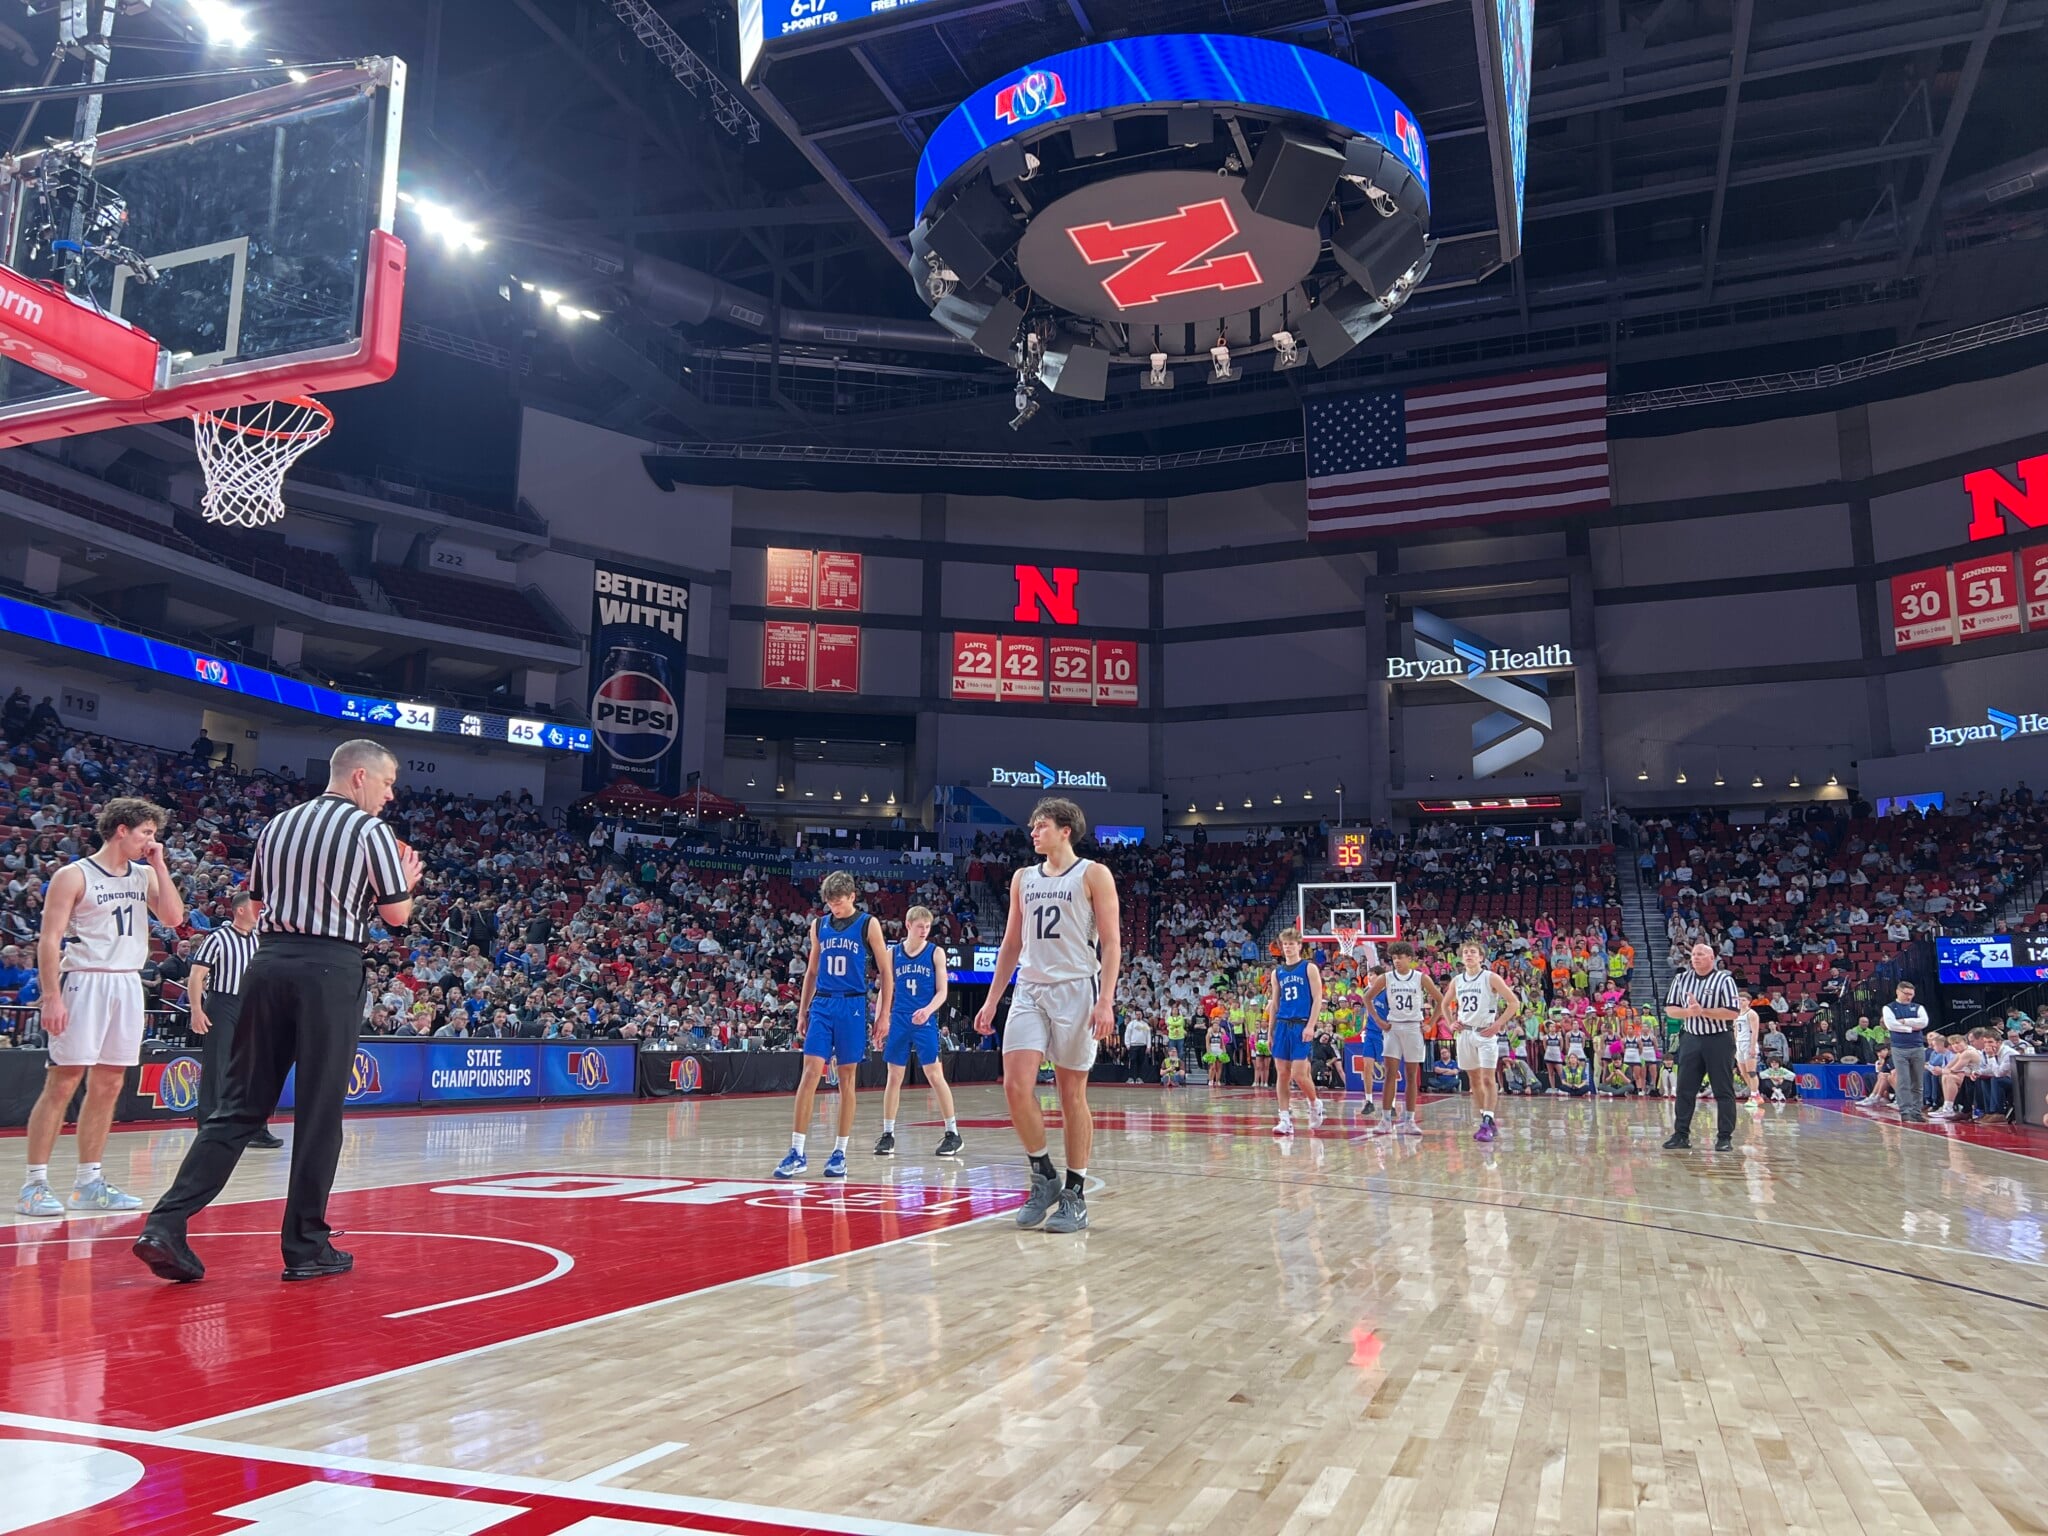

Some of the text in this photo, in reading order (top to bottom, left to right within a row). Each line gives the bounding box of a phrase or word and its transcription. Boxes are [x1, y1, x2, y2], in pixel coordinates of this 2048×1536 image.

[782, 11, 838, 33] 3-POINT FG
[1066, 197, 1262, 308] N
[1963, 453, 2048, 542] N
[437, 552, 462, 566] 222
[1961, 565, 2008, 580] JENNINGS
[595, 569, 689, 610] BETTER
[1014, 564, 1079, 625] N
[1910, 582, 1927, 591] IVY
[1968, 577, 2005, 607] 51
[1900, 591, 1940, 620] 30
[599, 597, 683, 642] WITH
[1961, 618, 1976, 630] N
[1897, 629, 1911, 642] N
[964, 642, 988, 650] LANTZ
[958, 651, 992, 674] 22
[1004, 654, 1038, 676] 42
[1054, 656, 1087, 679] 52
[1104, 659, 1131, 681] 10
[1386, 643, 1573, 682] Bryan Health
[64, 694, 95, 712] 119
[406, 709, 430, 726] 34
[462, 714, 481, 725] 4th
[512, 725, 534, 740] 45
[597, 702, 673, 731] PEPSI
[460, 723, 481, 736] 1:41
[1929, 724, 1997, 746] Bryan
[408, 760, 435, 773] 120
[611, 763, 656, 774] ZERO SUGAR
[991, 768, 1107, 787] Bryan Health
[1338, 846, 1362, 866] 35
[688, 859, 743, 872] ACCOUNTING
[753, 865, 795, 876] FIANCIAL
[872, 870, 904, 878] TALENT
[97, 892, 146, 905] CONCORDIA
[1025, 891, 1072, 904] CONCORDIA
[111, 904, 132, 936] 11
[1033, 905, 1060, 939] 12
[820, 938, 859, 955] BLUEJAYS
[1950, 937, 1995, 945] CONCORDIA
[946, 956, 991, 967] :41 45
[1989, 949, 2009, 961] 34
[827, 955, 847, 976] 10
[895, 964, 931, 978] BLUEJAYS
[906, 979, 917, 996] 4
[1285, 986, 1298, 1001] 23
[1395, 995, 1413, 1011] 34
[1462, 995, 1478, 1012] 23
[466, 1050, 502, 1068] STATE
[431, 1069, 531, 1088] CHAMPIONSHIPS
